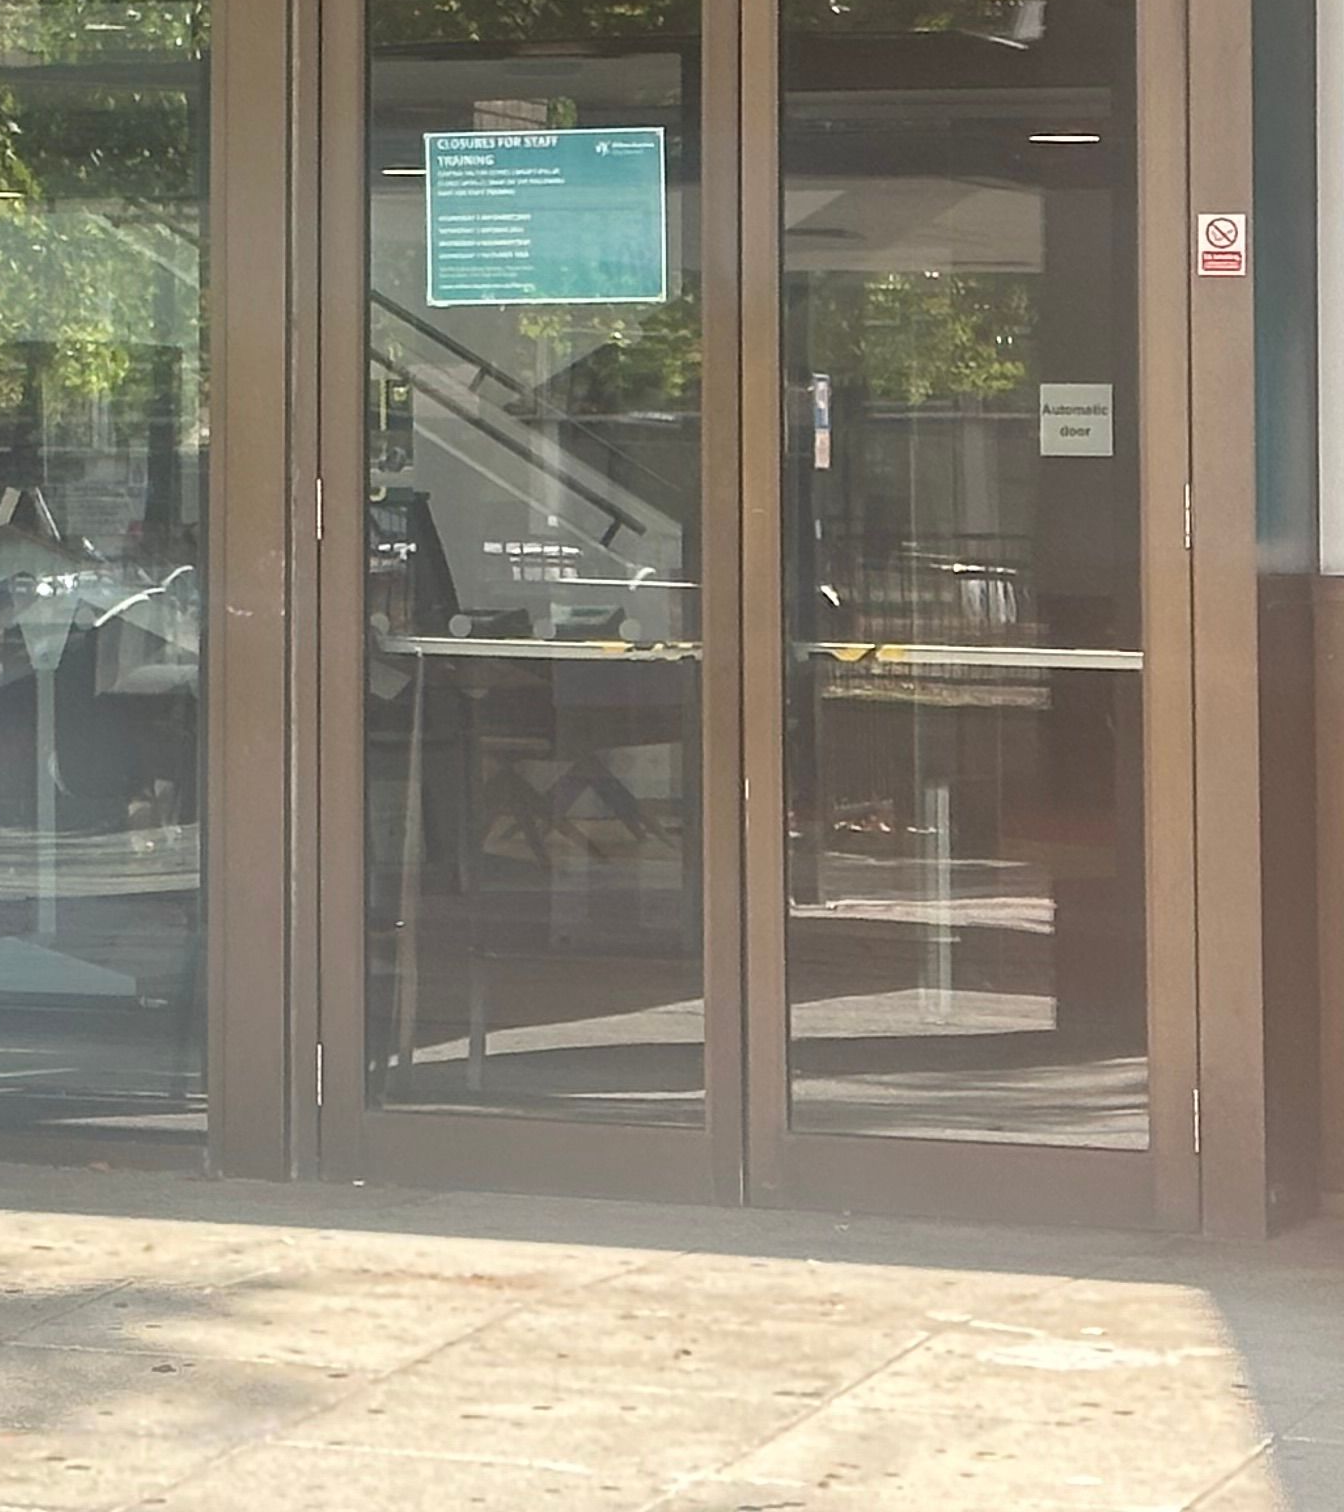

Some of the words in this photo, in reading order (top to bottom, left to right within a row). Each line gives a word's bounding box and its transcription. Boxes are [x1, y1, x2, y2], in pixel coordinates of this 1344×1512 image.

[437, 138, 495, 150] CLOSURES
[497, 137, 521, 148] FOR
[523, 135, 559, 148] STAFF
[437, 155, 496, 167] TRAINING
[1042, 403, 1109, 416] Automatic
[1059, 425, 1092, 438] door
